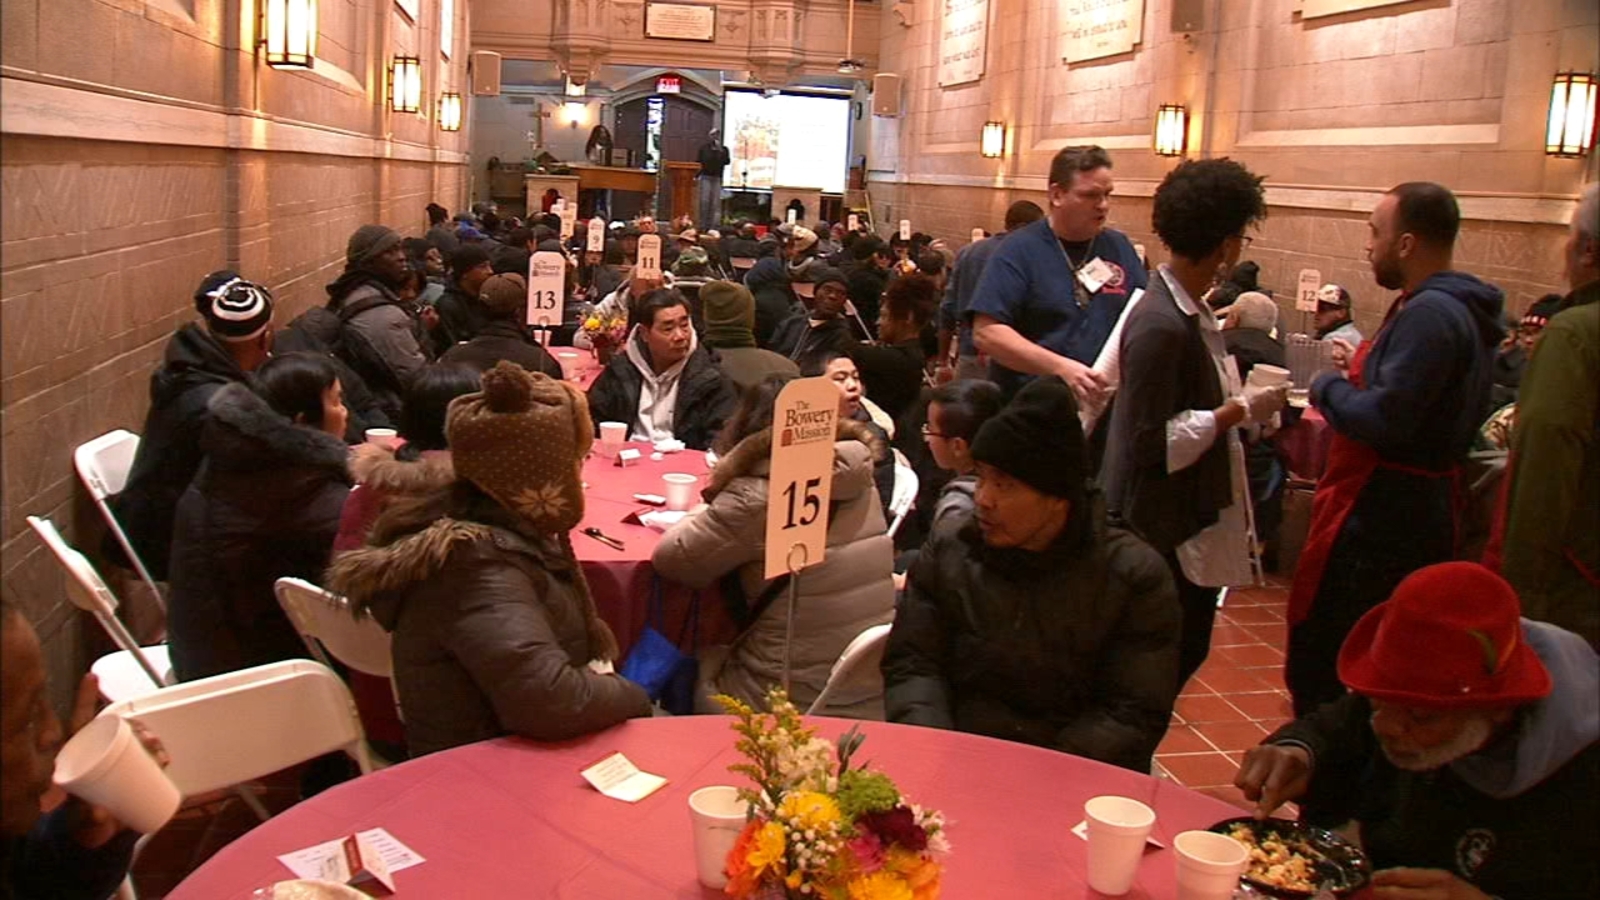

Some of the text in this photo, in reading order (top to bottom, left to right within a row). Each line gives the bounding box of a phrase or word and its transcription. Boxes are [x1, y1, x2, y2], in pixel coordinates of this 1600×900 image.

[642, 256, 655, 269] 11
[533, 290, 556, 310] 13
[1302, 290, 1316, 302] 12
[795, 400, 811, 410] The
[785, 409, 835, 428] Bowery
[792, 425, 831, 440] Mission
[781, 476, 822, 530] 15
